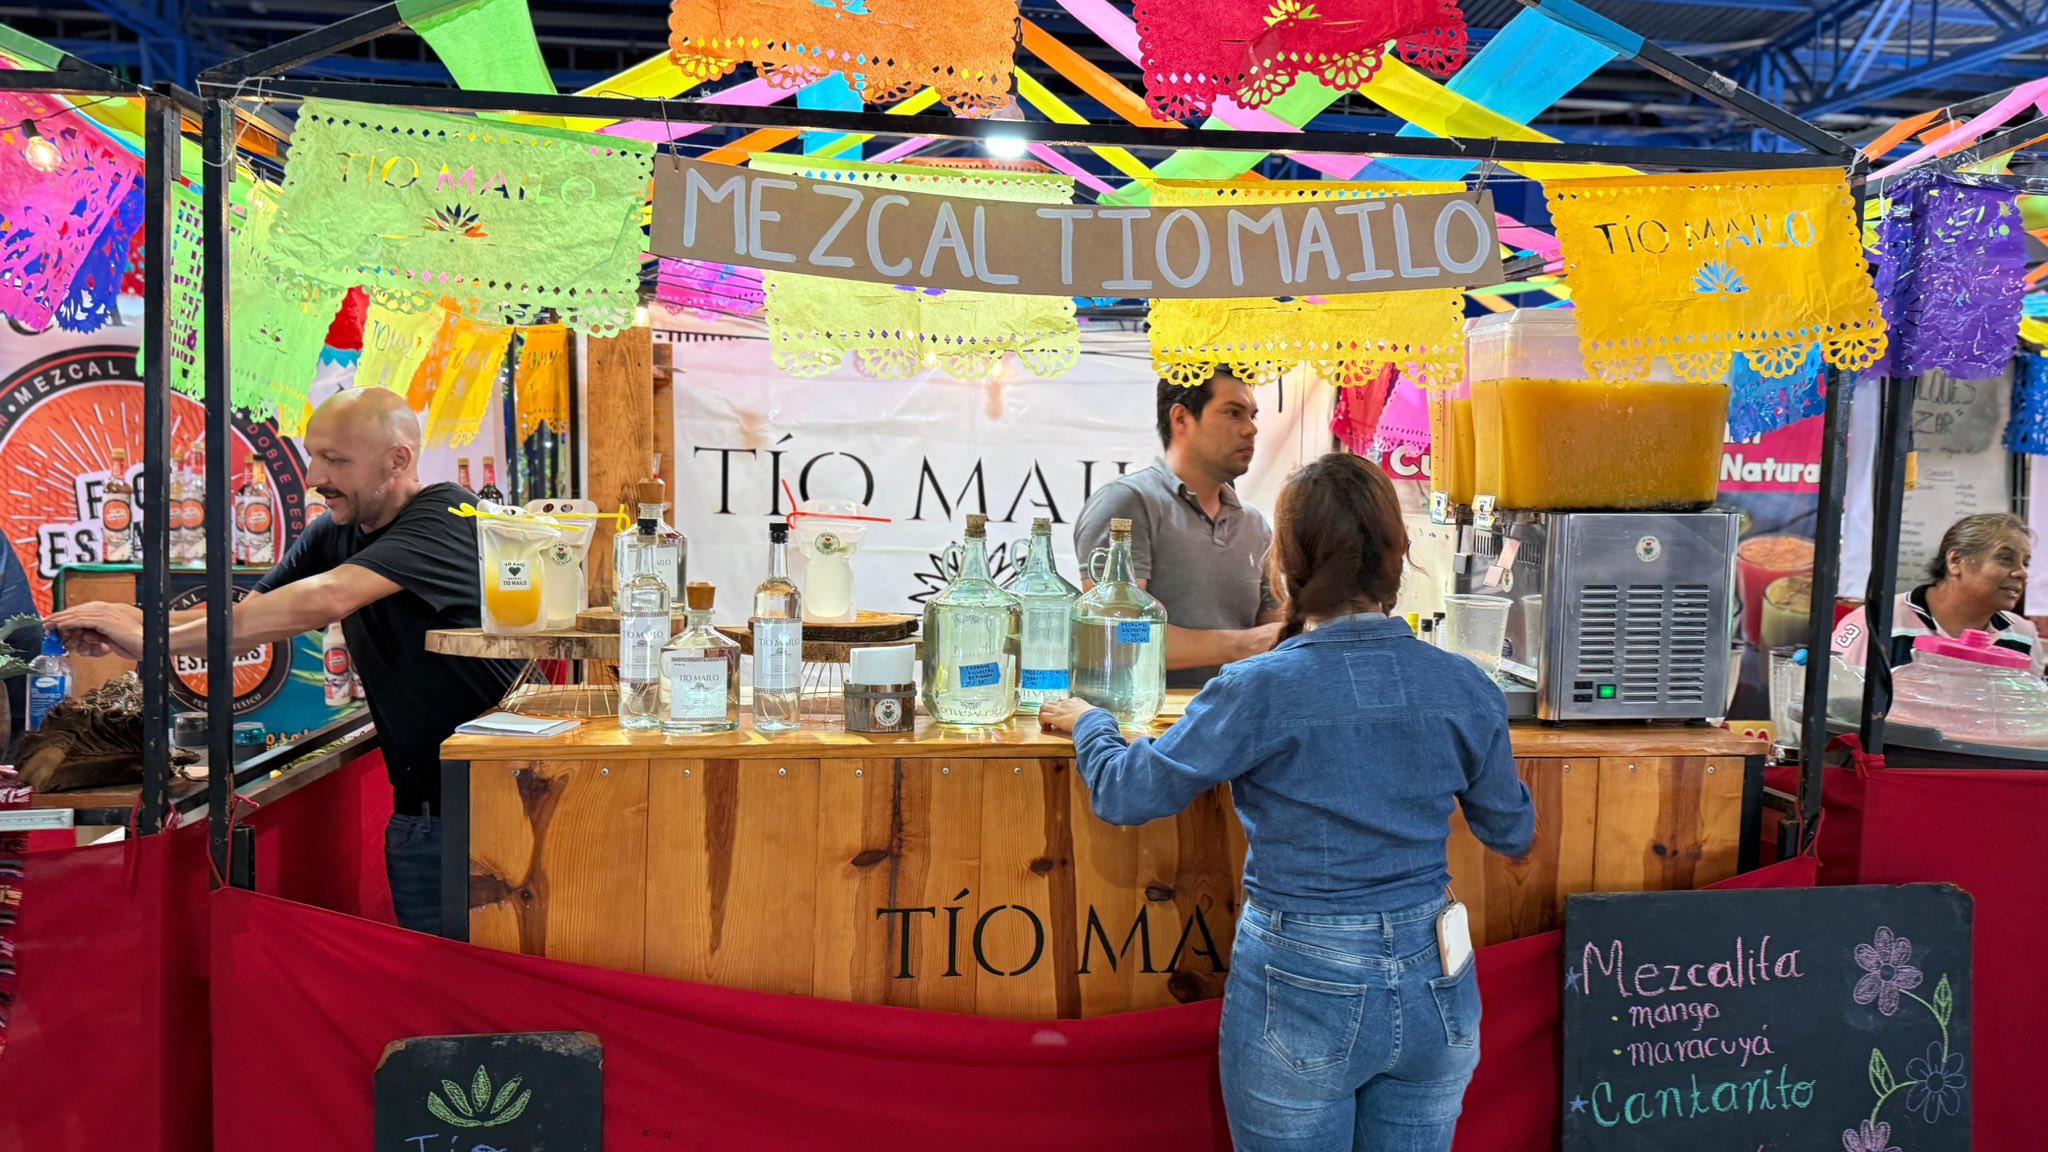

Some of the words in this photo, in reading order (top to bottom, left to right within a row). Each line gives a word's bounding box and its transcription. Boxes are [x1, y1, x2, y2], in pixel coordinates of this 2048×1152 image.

[683, 168, 1020, 285] MEZCAL
[1036, 207, 1211, 291] TIO
[1227, 199, 1491, 287] MAILO
[1594, 214, 1669, 255] TÍO
[1685, 210, 1815, 251] MAILO
[13, 359, 121, 405] MEZCAL
[247, 424, 291, 484] DOBLE
[694, 432, 875, 517] TÍO
[906, 455, 1134, 524] MAI
[693, 673, 720, 682] MAILO
[876, 887, 1045, 980] TÍO
[1074, 904, 1230, 975] MA
[1582, 935, 1804, 998] Mezcalita
[1628, 1001, 1721, 1031] mango
[1627, 1025, 1775, 1068] maracuyá
[1591, 1063, 1817, 1128] Cantarito
